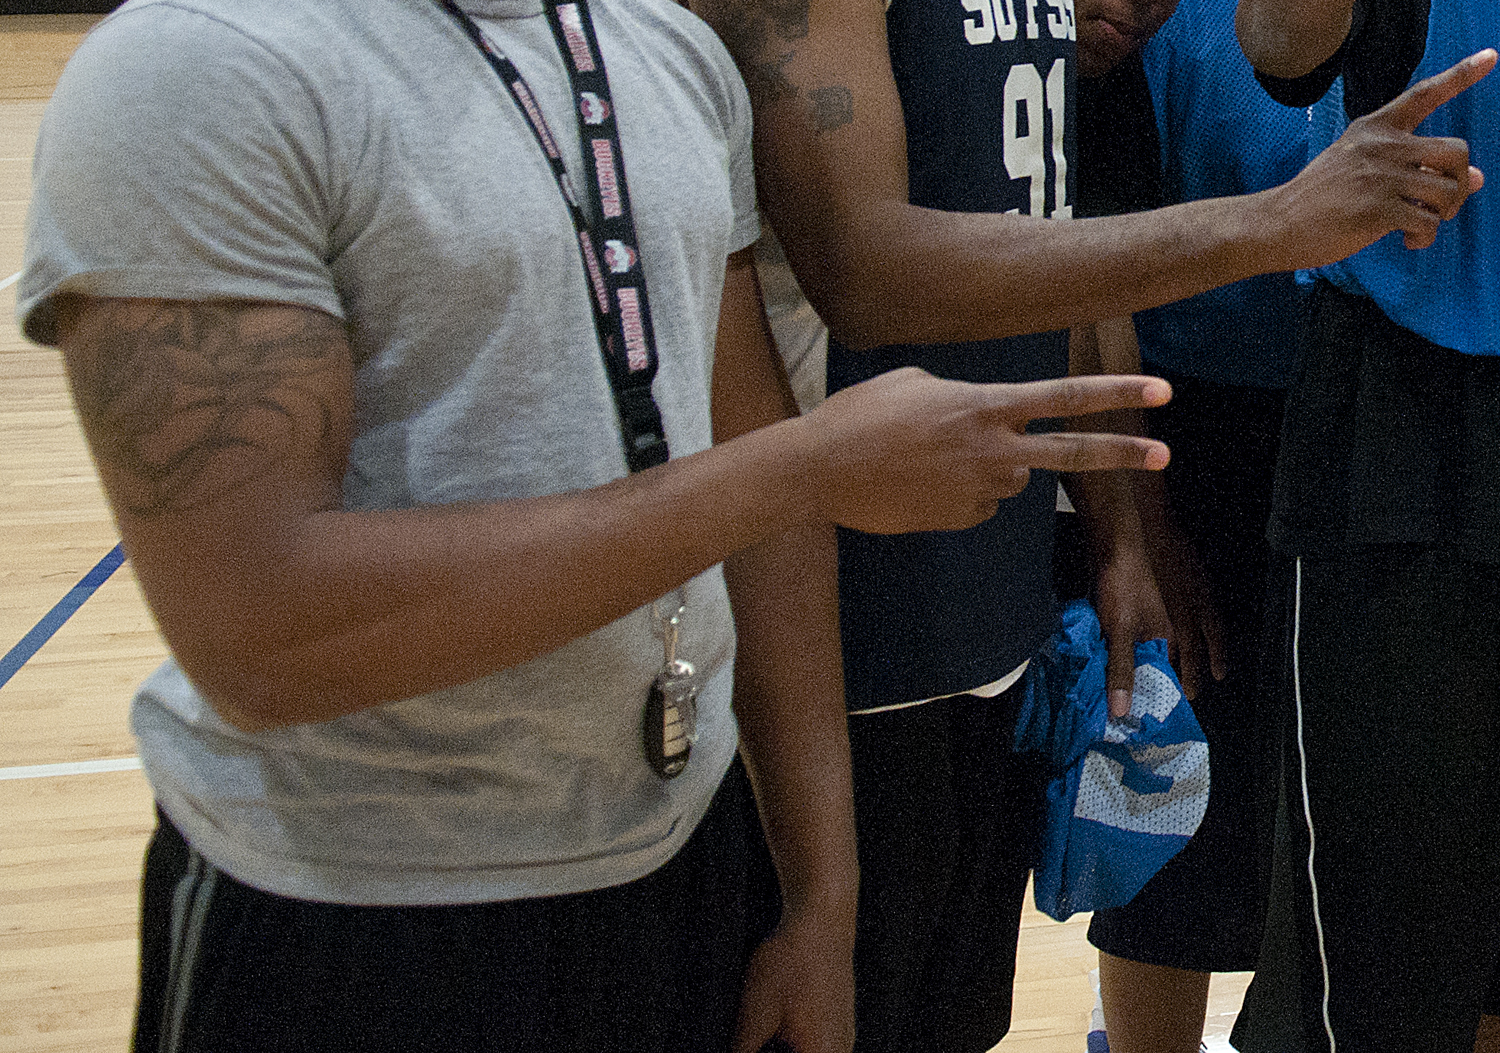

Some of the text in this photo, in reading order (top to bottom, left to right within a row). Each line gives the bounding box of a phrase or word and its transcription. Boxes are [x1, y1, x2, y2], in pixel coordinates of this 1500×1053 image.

[591, 138, 622, 218] BUCKEYES
[1003, 58, 1073, 220] 91
[617, 288, 649, 374] BUCKEYES
